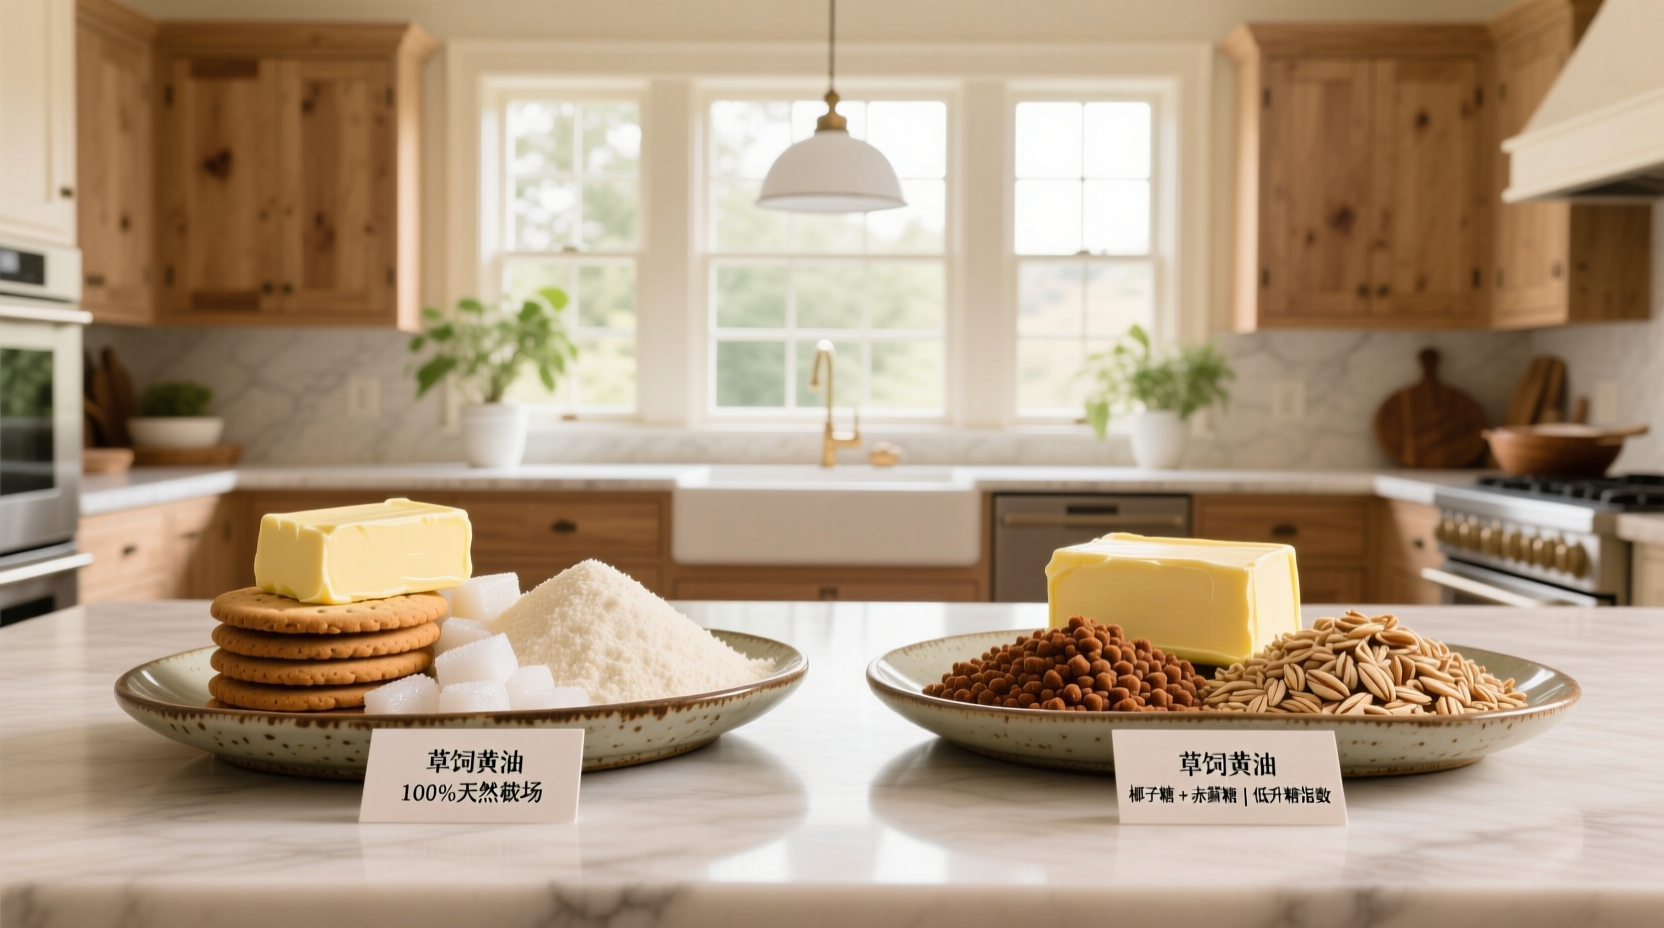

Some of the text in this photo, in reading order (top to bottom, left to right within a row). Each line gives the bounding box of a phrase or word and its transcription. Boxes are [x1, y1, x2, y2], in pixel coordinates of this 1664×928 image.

[426, 749, 523, 774] 草饲黄油
[1179, 751, 1276, 776] 草饲黄油
